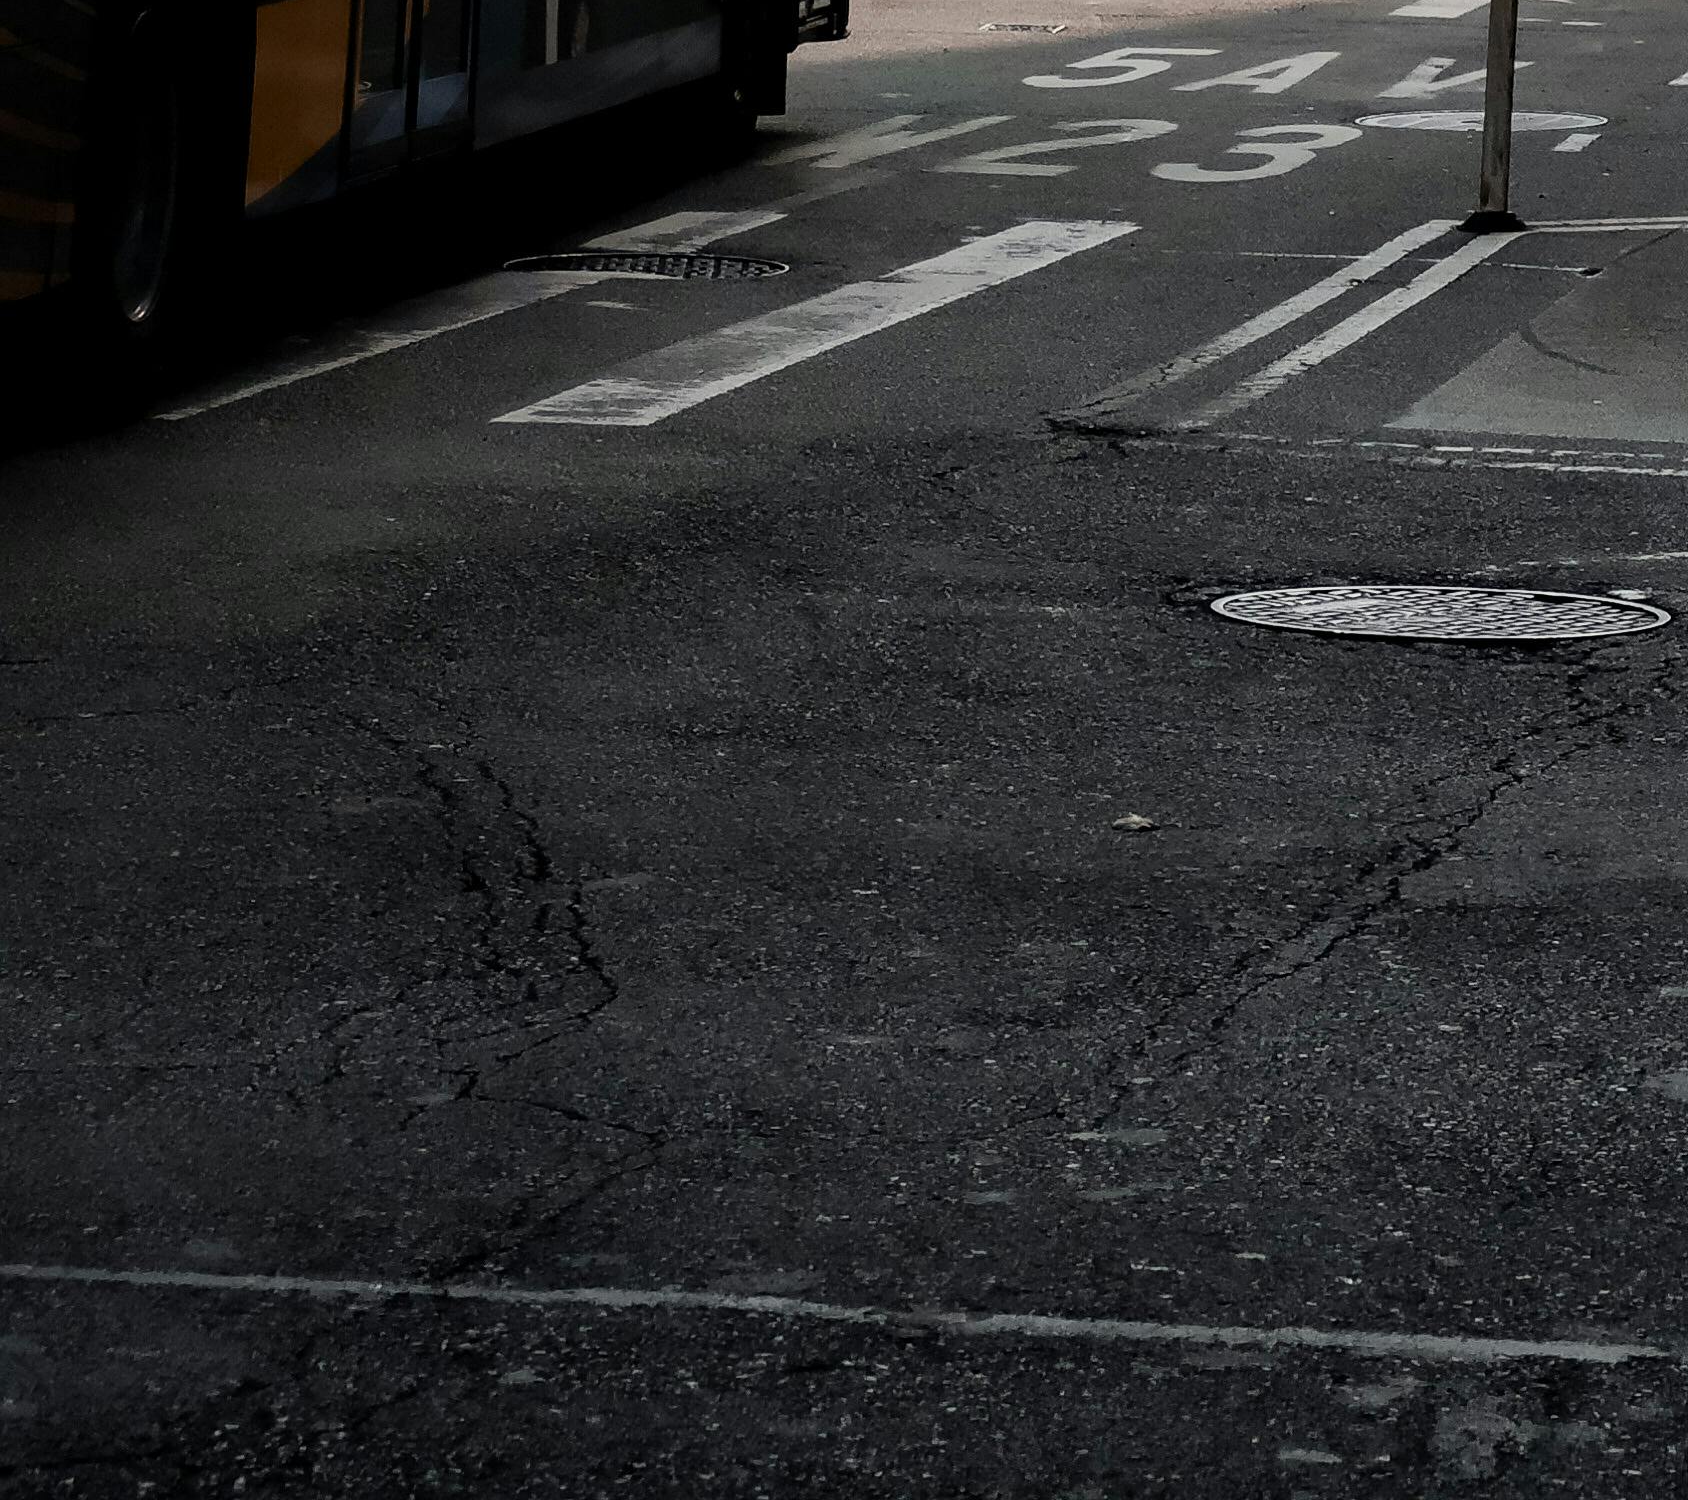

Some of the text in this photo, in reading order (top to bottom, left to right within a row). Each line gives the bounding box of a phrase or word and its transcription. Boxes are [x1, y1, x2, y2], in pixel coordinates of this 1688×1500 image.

[1022, 47, 1536, 100] 5 AV
[922, 118, 1364, 182] 23
